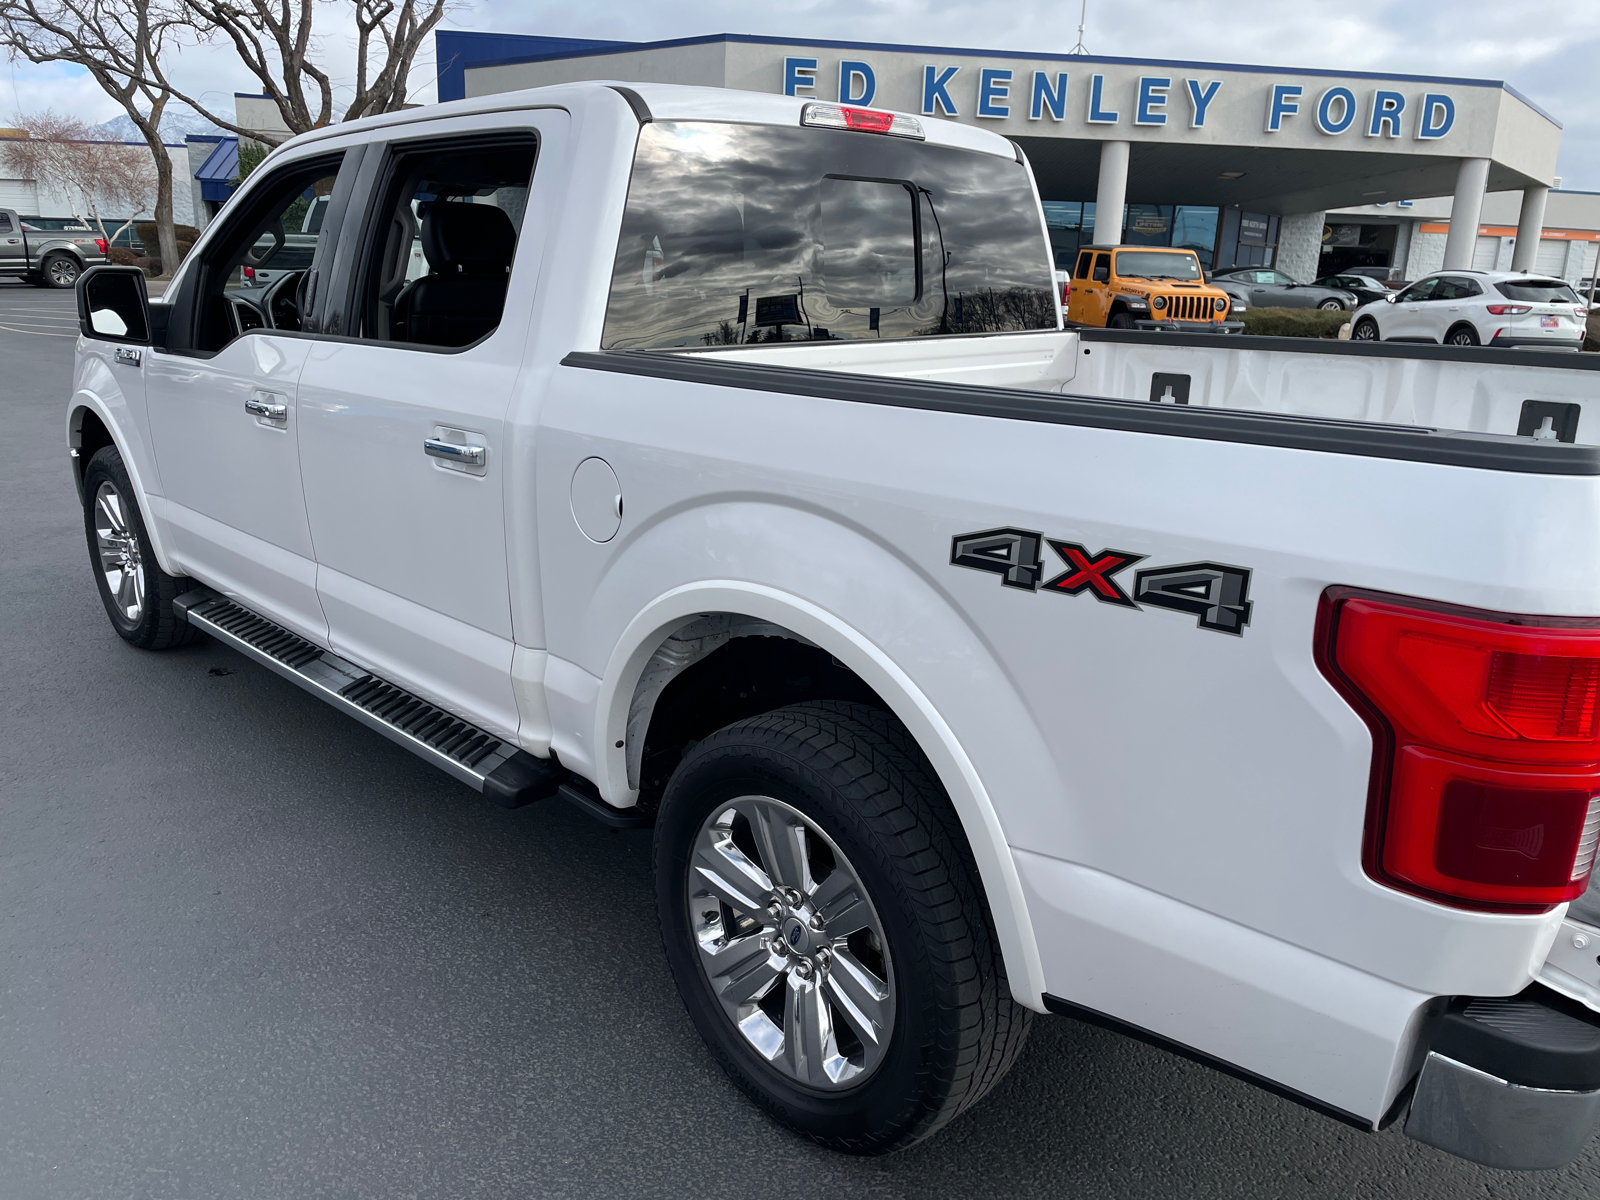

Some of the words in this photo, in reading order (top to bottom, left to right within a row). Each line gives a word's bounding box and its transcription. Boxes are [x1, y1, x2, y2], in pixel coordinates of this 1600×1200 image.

[782, 56, 877, 108] ED
[921, 64, 1224, 129] KENLEY
[1264, 83, 1456, 140] FORD
[949, 526, 1254, 638] 4X4
